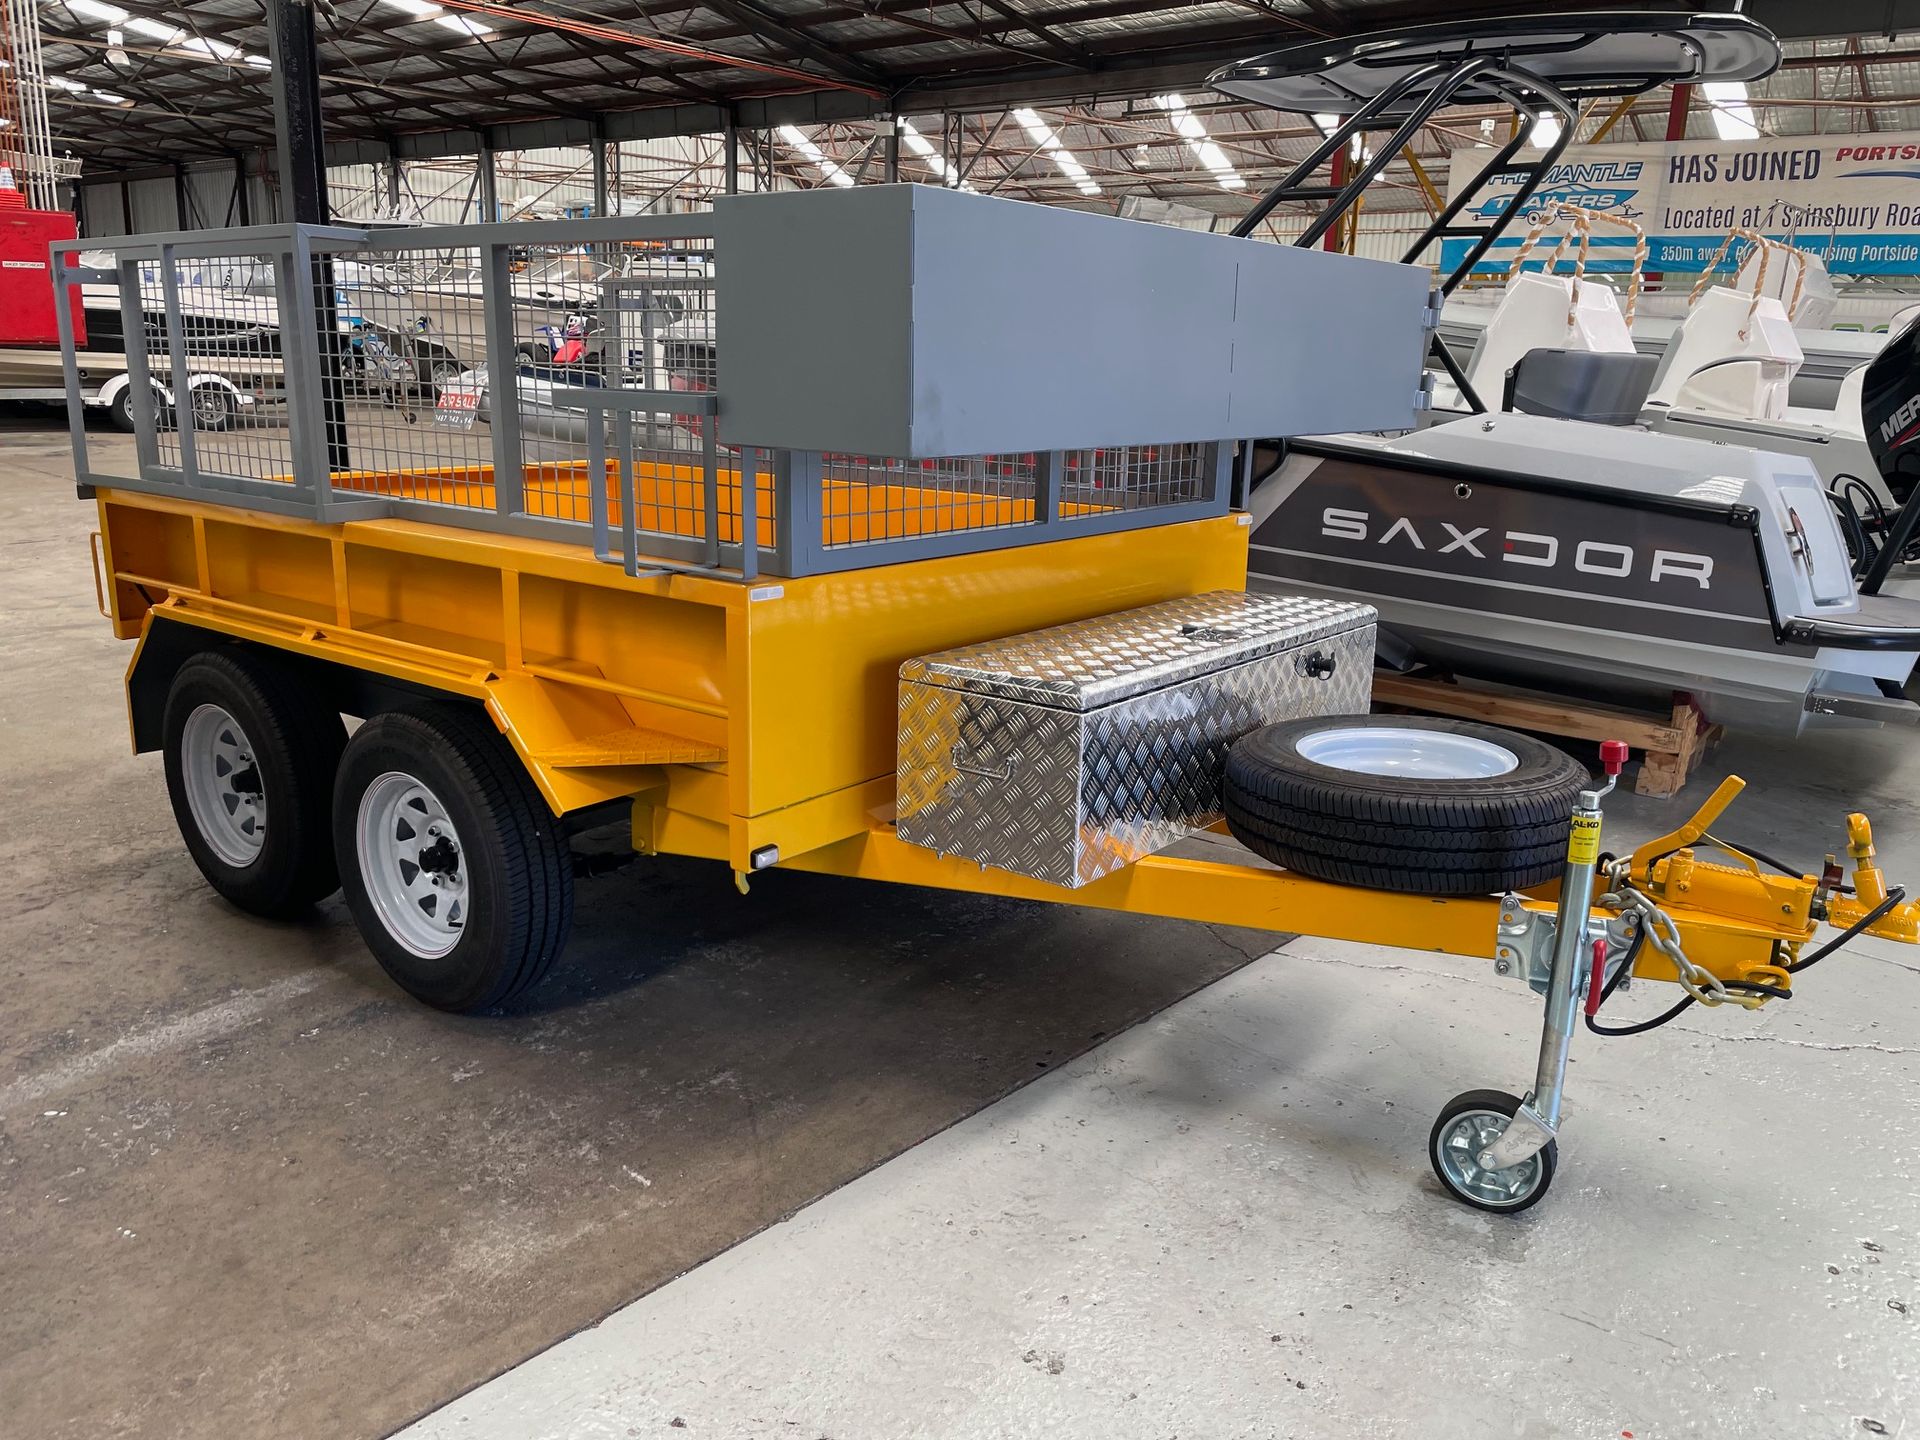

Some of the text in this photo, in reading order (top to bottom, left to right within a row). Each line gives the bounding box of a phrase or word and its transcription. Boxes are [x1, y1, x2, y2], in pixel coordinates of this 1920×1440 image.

[1669, 150, 1821, 184] HAS JOINED
[1664, 206, 1735, 229] Located
[1741, 205, 1761, 228] at
[1661, 246, 1693, 261] 350m
[1861, 245, 1918, 261] Portside
[1322, 507, 1714, 590] SAXDOR
[1573, 820, 1600, 829] AL-KO
